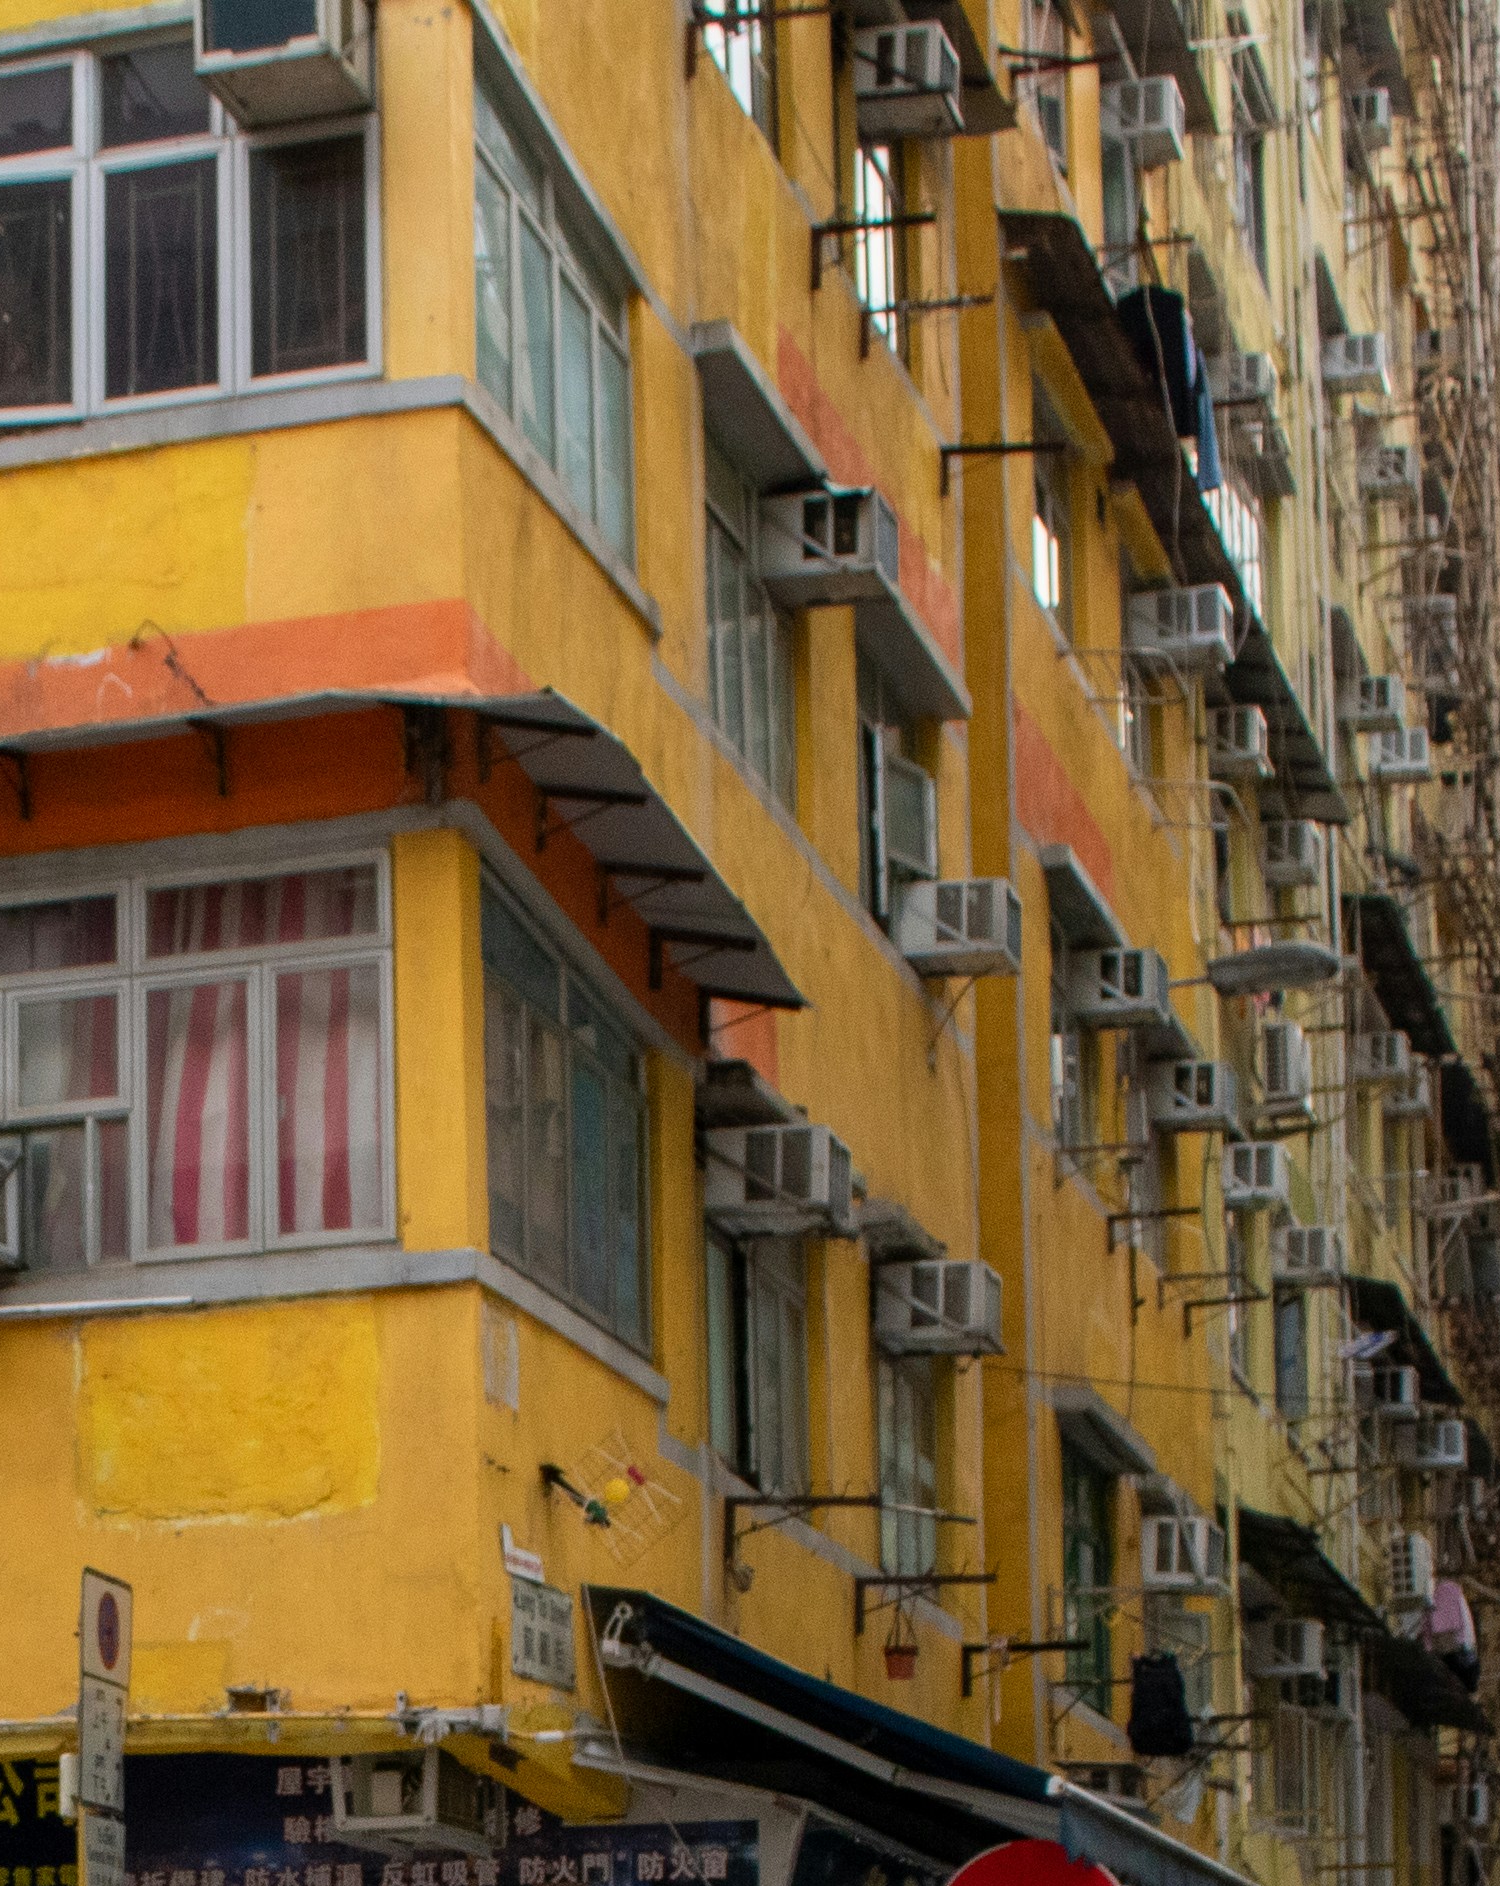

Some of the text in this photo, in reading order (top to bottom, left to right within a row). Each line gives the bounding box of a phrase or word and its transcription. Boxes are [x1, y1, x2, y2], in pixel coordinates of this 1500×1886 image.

[519, 1853, 611, 1885] 防火門
[636, 1845, 729, 1880] 防火窗
